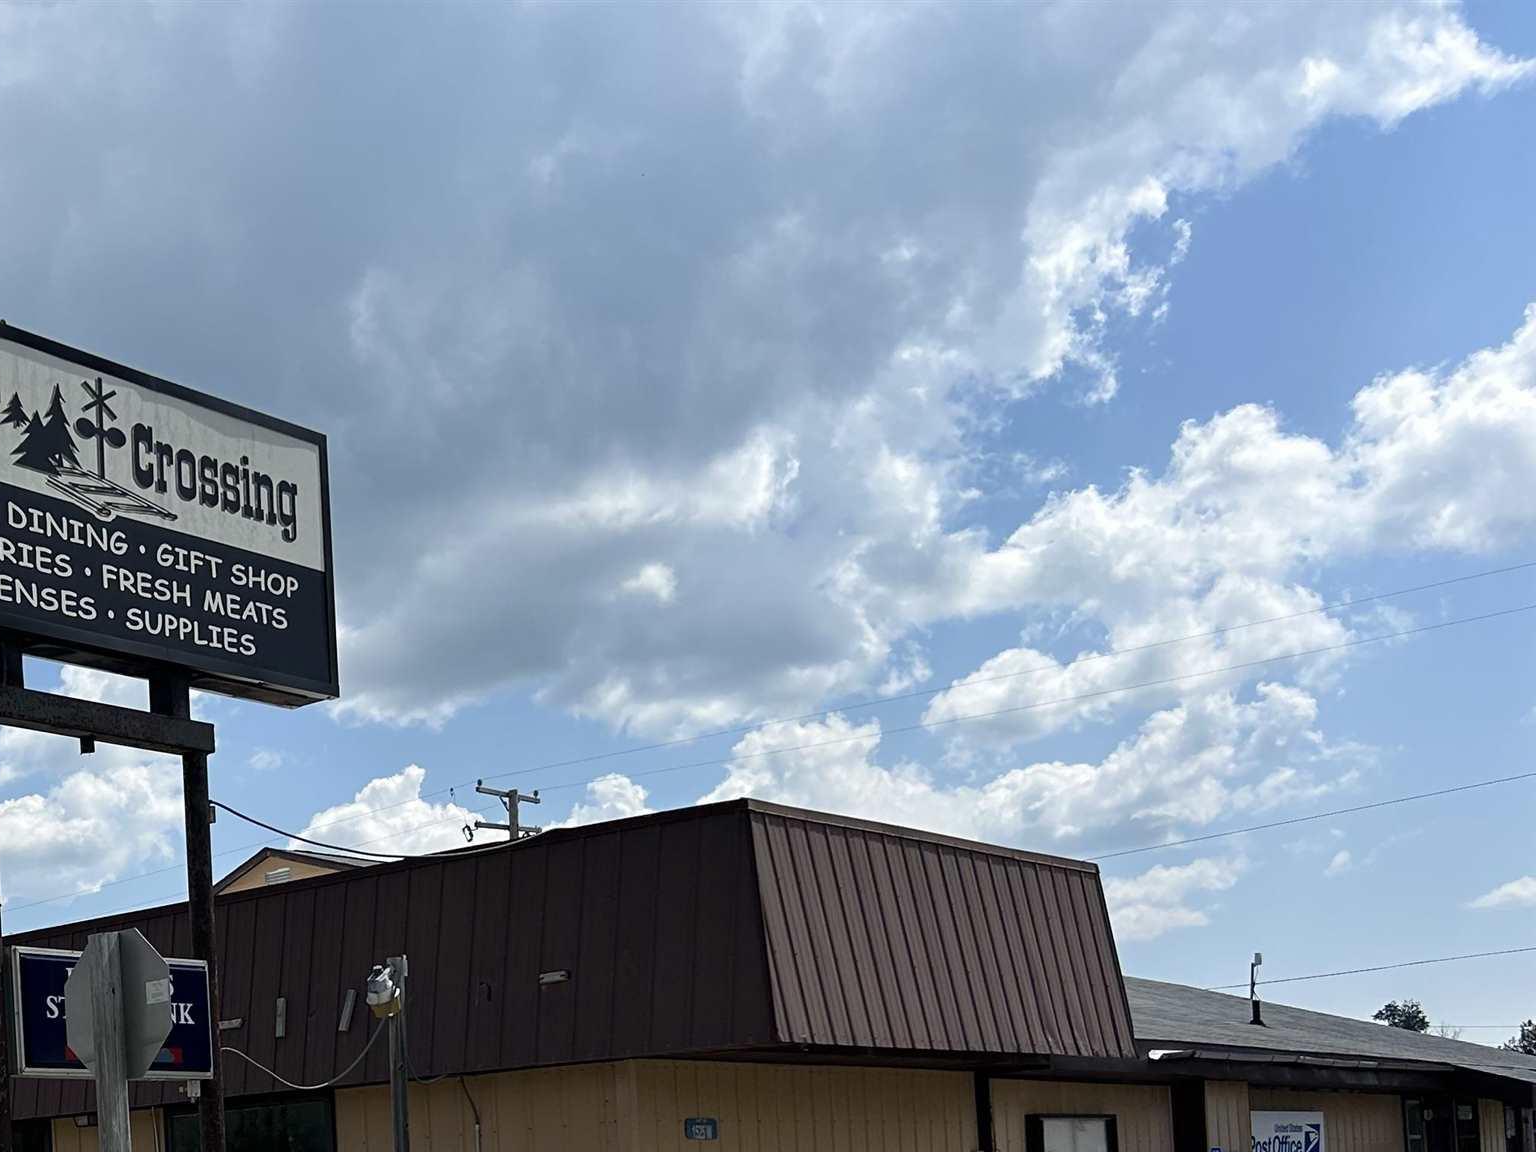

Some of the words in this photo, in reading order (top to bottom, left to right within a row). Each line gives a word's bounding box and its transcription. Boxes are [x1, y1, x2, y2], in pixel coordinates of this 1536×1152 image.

[131, 422, 298, 543] Crossing
[7, 501, 128, 556] DINING
[156, 543, 222, 579] GIFT
[230, 564, 299, 599] SHOP
[102, 565, 191, 607] FRESH
[203, 589, 289, 631] MEATS
[125, 608, 257, 656] SUPPLIES
